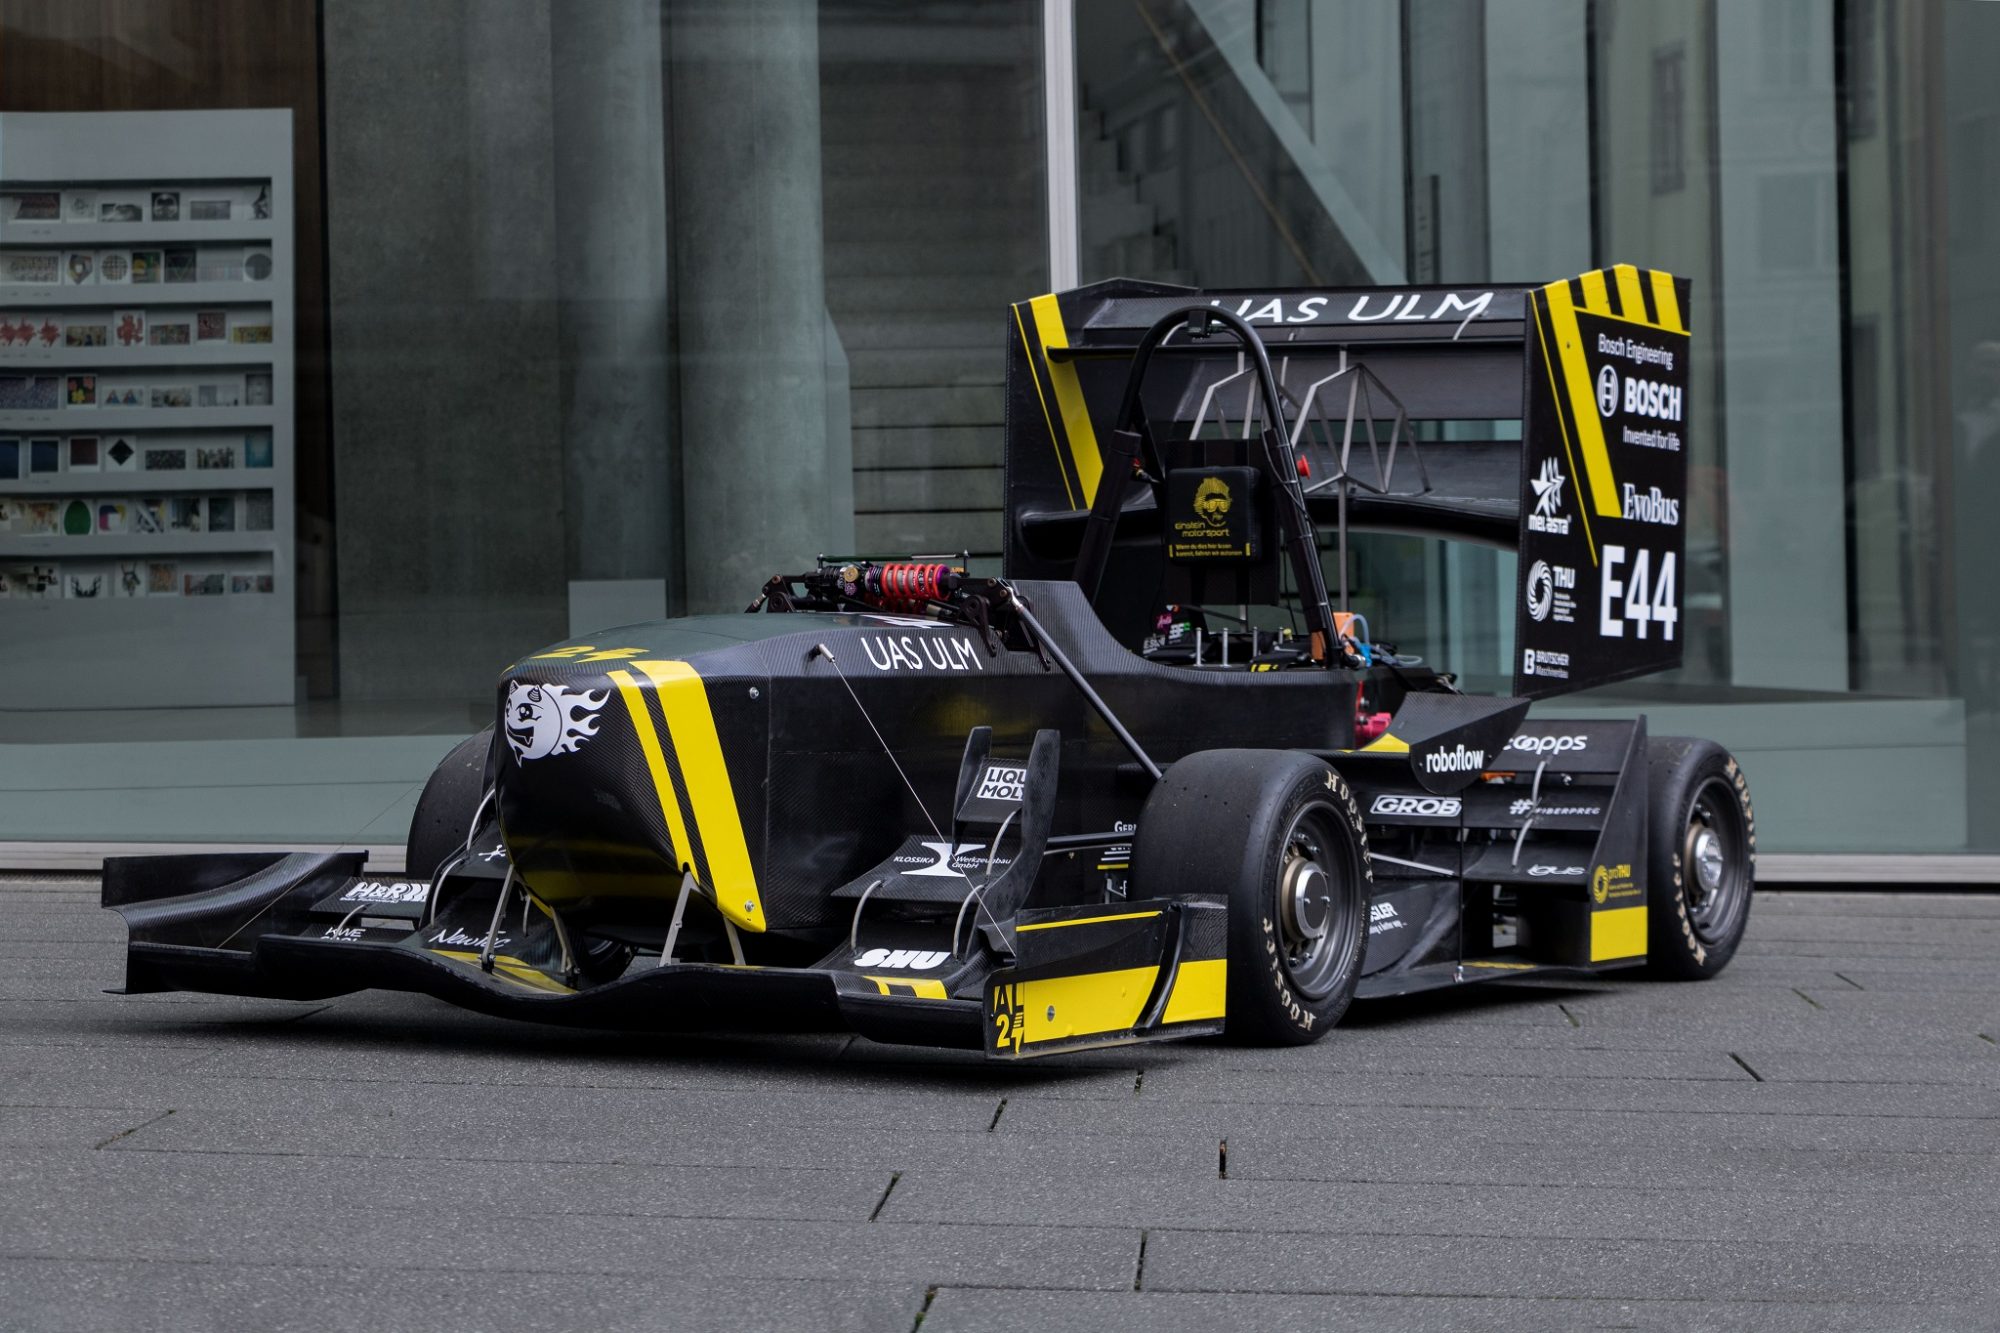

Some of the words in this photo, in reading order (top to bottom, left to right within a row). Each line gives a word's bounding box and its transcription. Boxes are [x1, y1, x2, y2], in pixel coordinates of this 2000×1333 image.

[1348, 291, 1494, 321] ULM
[1598, 332, 1625, 357] Bosch
[1626, 339, 1674, 371] Engineering
[1624, 377, 1682, 421] BOSCH
[1623, 425, 1657, 448] Invented
[1657, 430, 1668, 450] for
[1668, 432, 1681, 451] life
[1623, 482, 1679, 526] EvoBus
[1552, 565, 1575, 589] THU
[1600, 544, 1678, 641] E44
[861, 636, 923, 671] UAS
[919, 636, 983, 671] ULM
[1426, 744, 1485, 773] roboflow
[1376, 798, 1461, 815] GROB
[893, 856, 935, 864] KLOSSIKA
[956, 856, 1012, 865] Werkzeubau
